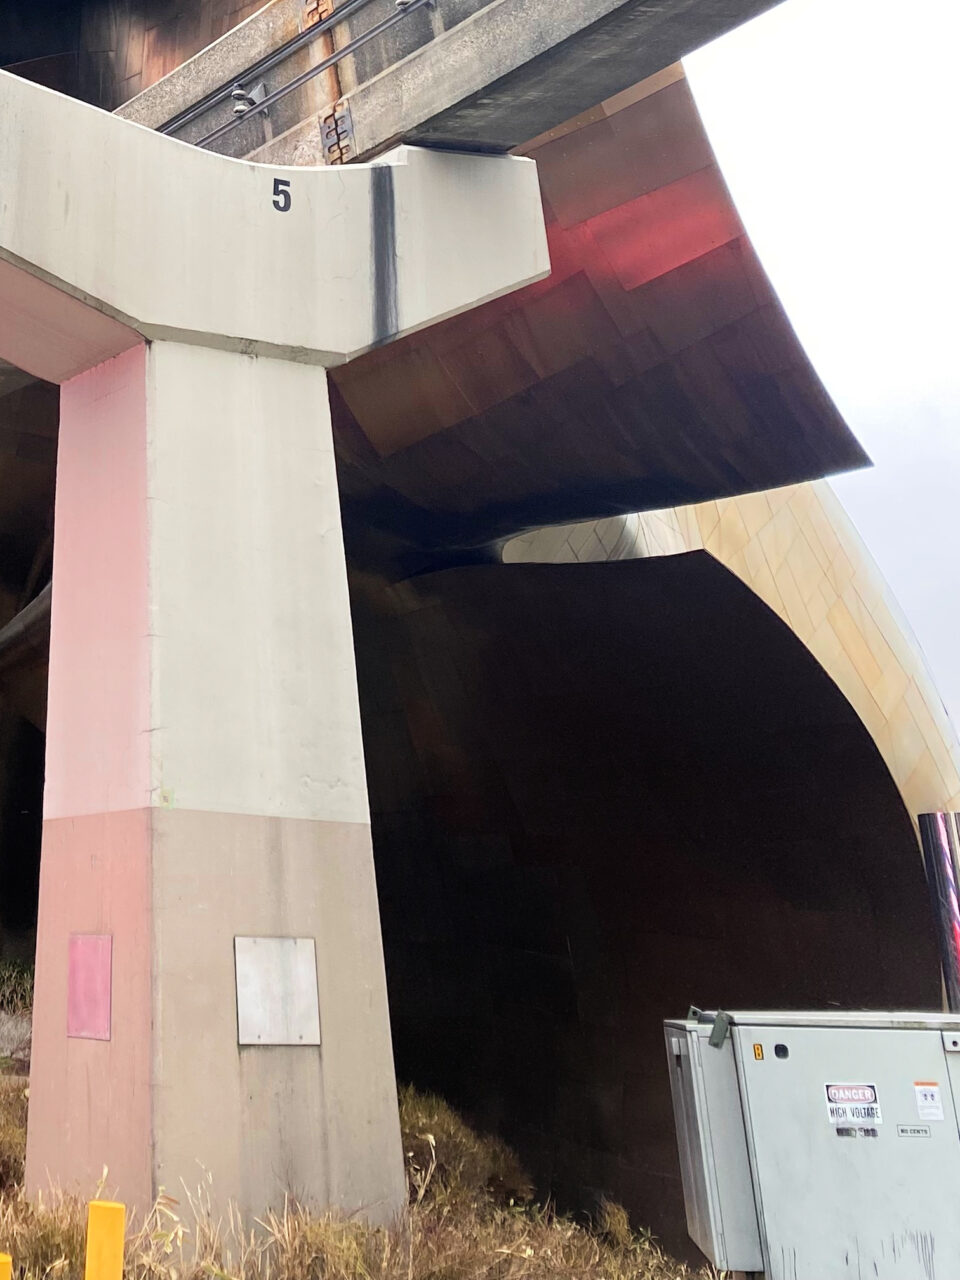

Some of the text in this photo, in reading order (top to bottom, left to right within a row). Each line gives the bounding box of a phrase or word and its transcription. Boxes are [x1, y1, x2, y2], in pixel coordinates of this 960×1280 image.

[272, 178, 291, 212] 5
[831, 1088, 872, 1100] DANGER
[829, 1107, 881, 1119] HIGH VOLTAGE
